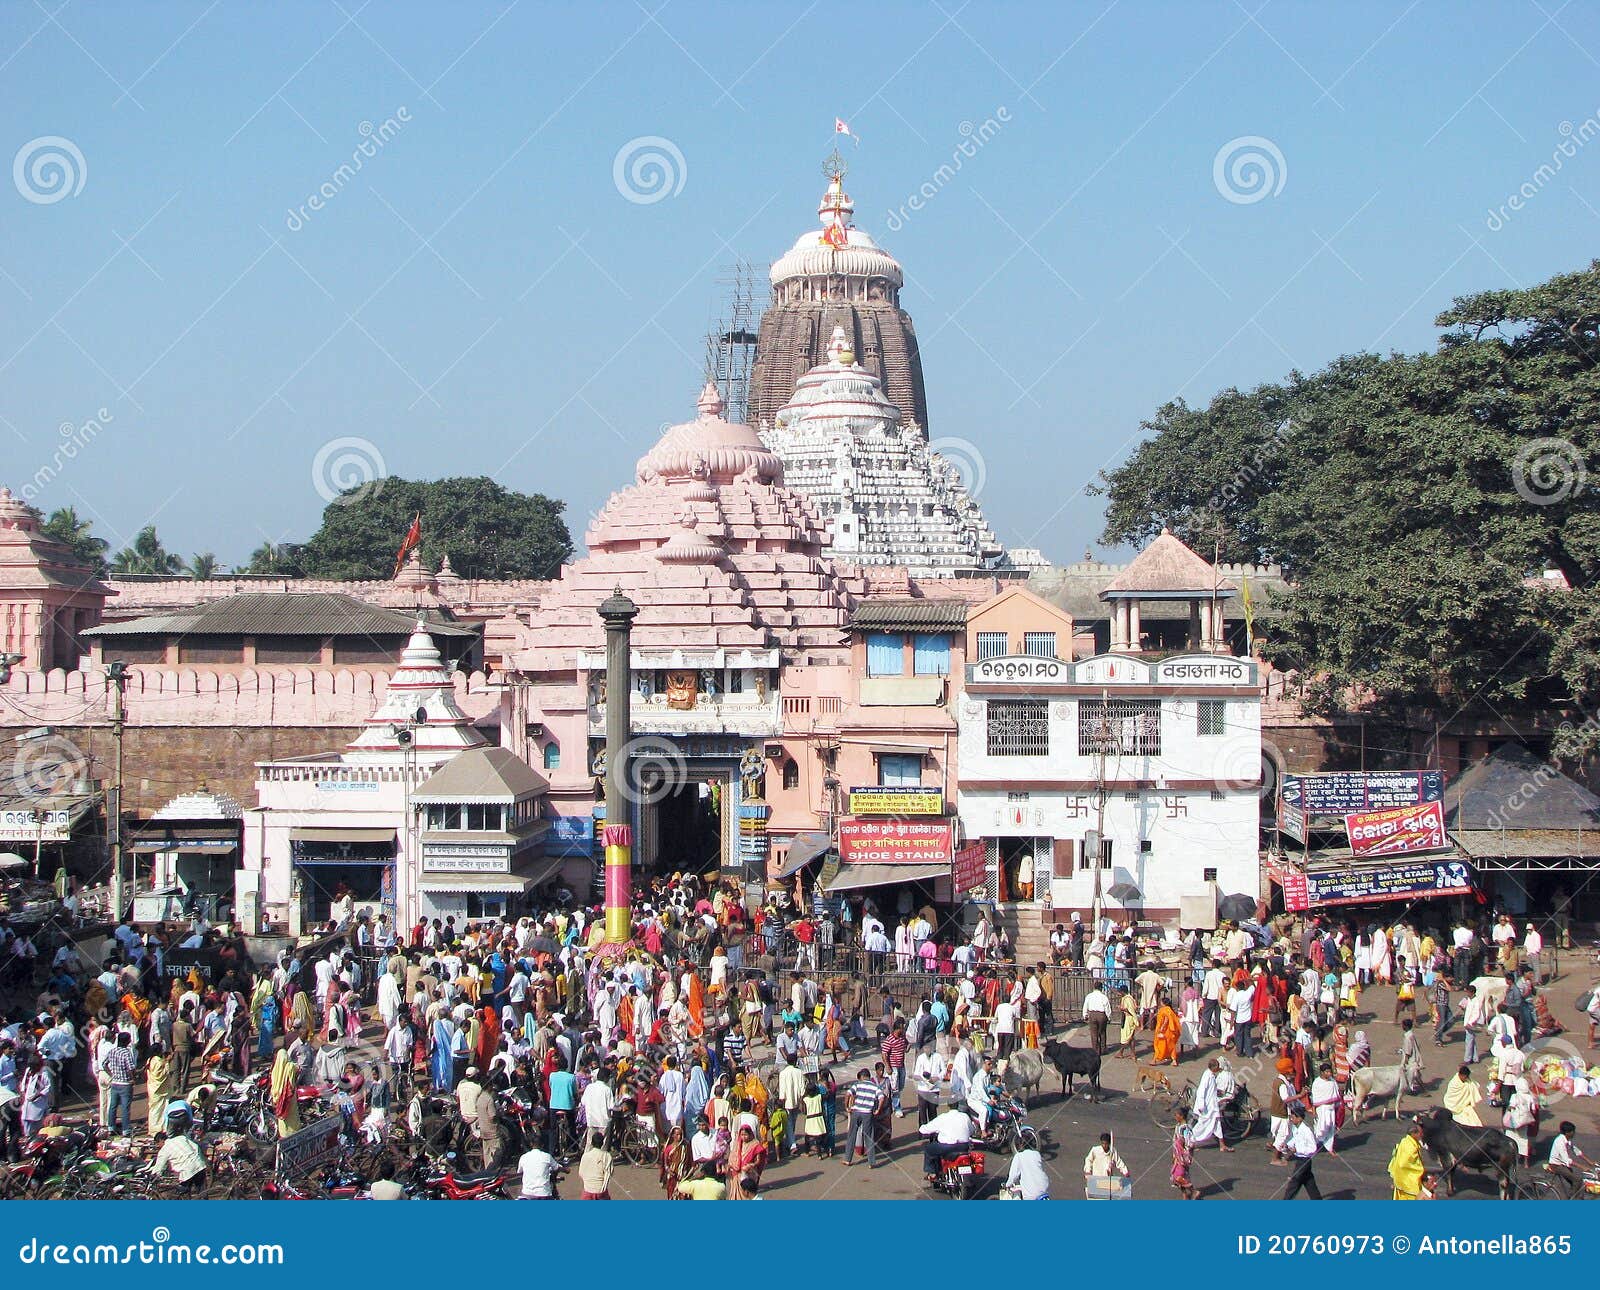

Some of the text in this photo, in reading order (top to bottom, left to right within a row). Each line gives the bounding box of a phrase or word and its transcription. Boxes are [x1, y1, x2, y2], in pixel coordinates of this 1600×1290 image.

[1219, 664, 1242, 678] मठ
[1368, 793, 1418, 801] SHOE STAND
[894, 851, 945, 859] STAND
[1378, 872, 1403, 880] SHOE
[1404, 869, 1434, 878] STAND
